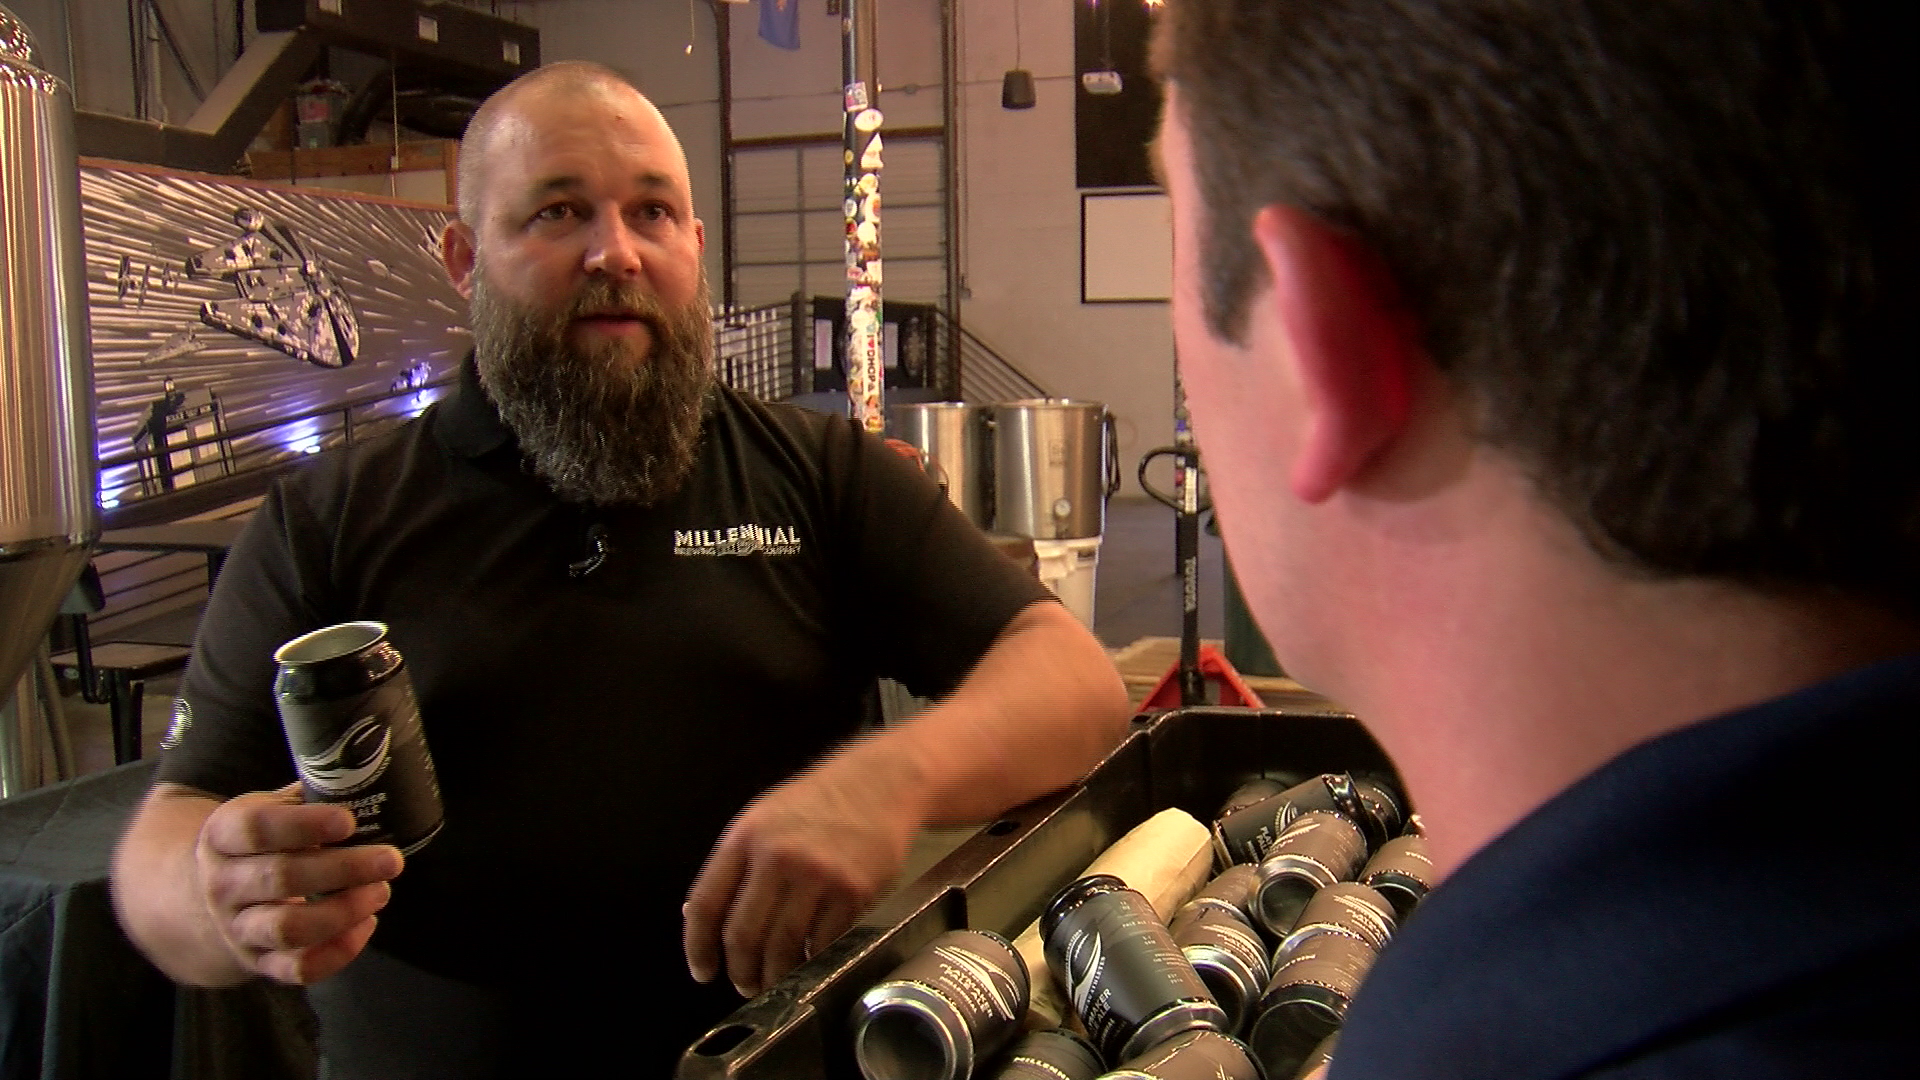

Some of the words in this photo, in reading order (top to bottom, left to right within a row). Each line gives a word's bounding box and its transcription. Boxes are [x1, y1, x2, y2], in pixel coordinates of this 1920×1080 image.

[674, 523, 801, 547] MILLENNIAL
[1184, 556, 1197, 613] TOYOTA
[1012, 1056, 1070, 1080] MILLENN
